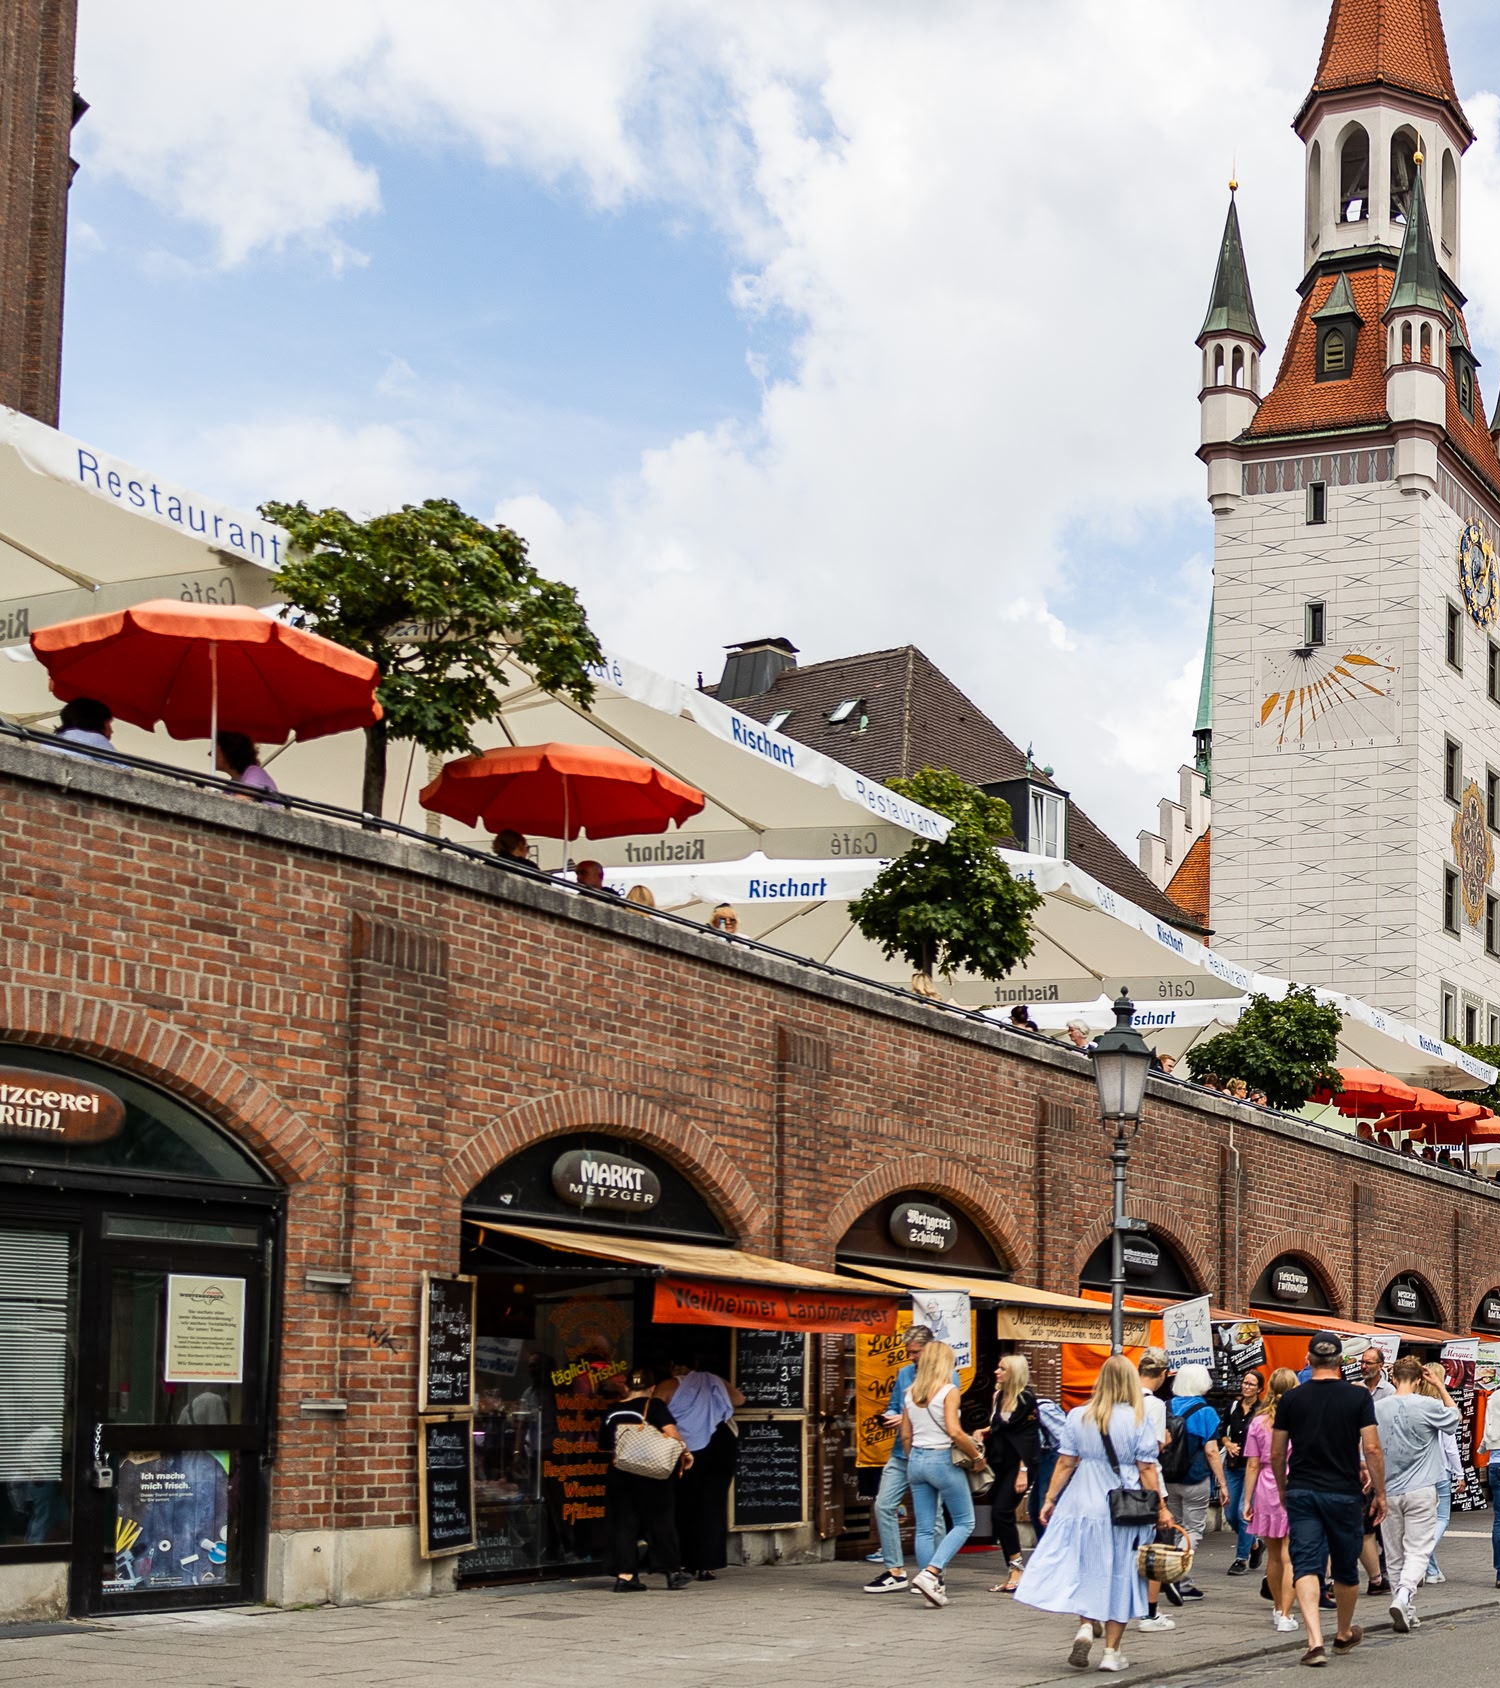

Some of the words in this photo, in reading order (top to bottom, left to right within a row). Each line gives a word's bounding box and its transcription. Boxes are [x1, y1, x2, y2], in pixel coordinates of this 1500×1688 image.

[77, 448, 282, 565] Restaurant
[731, 716, 795, 768] Rischart
[855, 779, 944, 838] Restaurant
[748, 877, 828, 899] Rischart
[1156, 923, 1185, 955] Rischart
[1129, 1010, 1176, 1027] ischart
[580, 1159, 646, 1191] MARKT
[569, 1182, 655, 1204] METZGER
[669, 1287, 777, 1318] Weilheimer
[786, 1297, 888, 1326] Landmetzger
[551, 1358, 591, 1387] täglich
[588, 1358, 629, 1394] frische
[750, 1424, 780, 1437] Imbiss
[141, 1472, 154, 1480] Ich
[156, 1472, 186, 1480] mache
[141, 1482, 163, 1490] mich
[164, 1481, 191, 1490] frisch.
